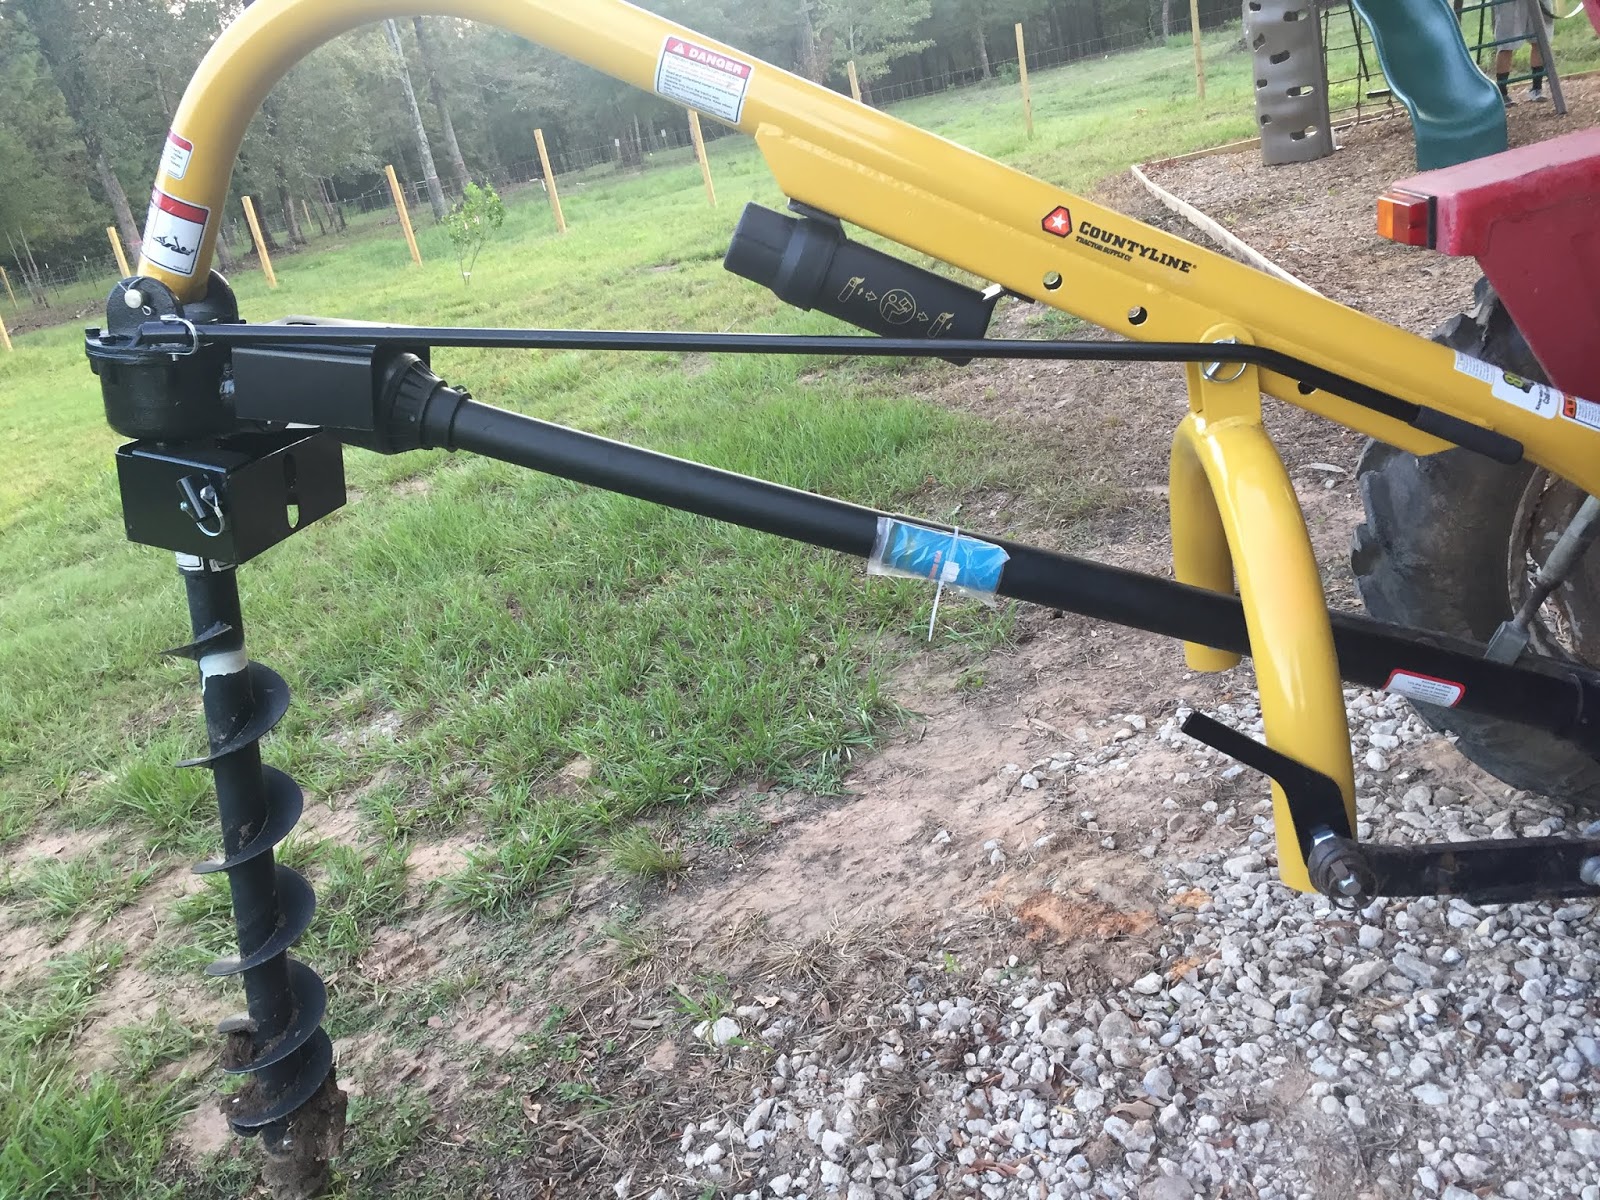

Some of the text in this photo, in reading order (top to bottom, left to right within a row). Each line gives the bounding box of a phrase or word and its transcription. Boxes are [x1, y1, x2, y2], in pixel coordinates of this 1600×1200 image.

[688, 47, 743, 75] DANGER
[1076, 236, 1103, 252] TRACTOR
[1103, 246, 1125, 259] SUPPLY
